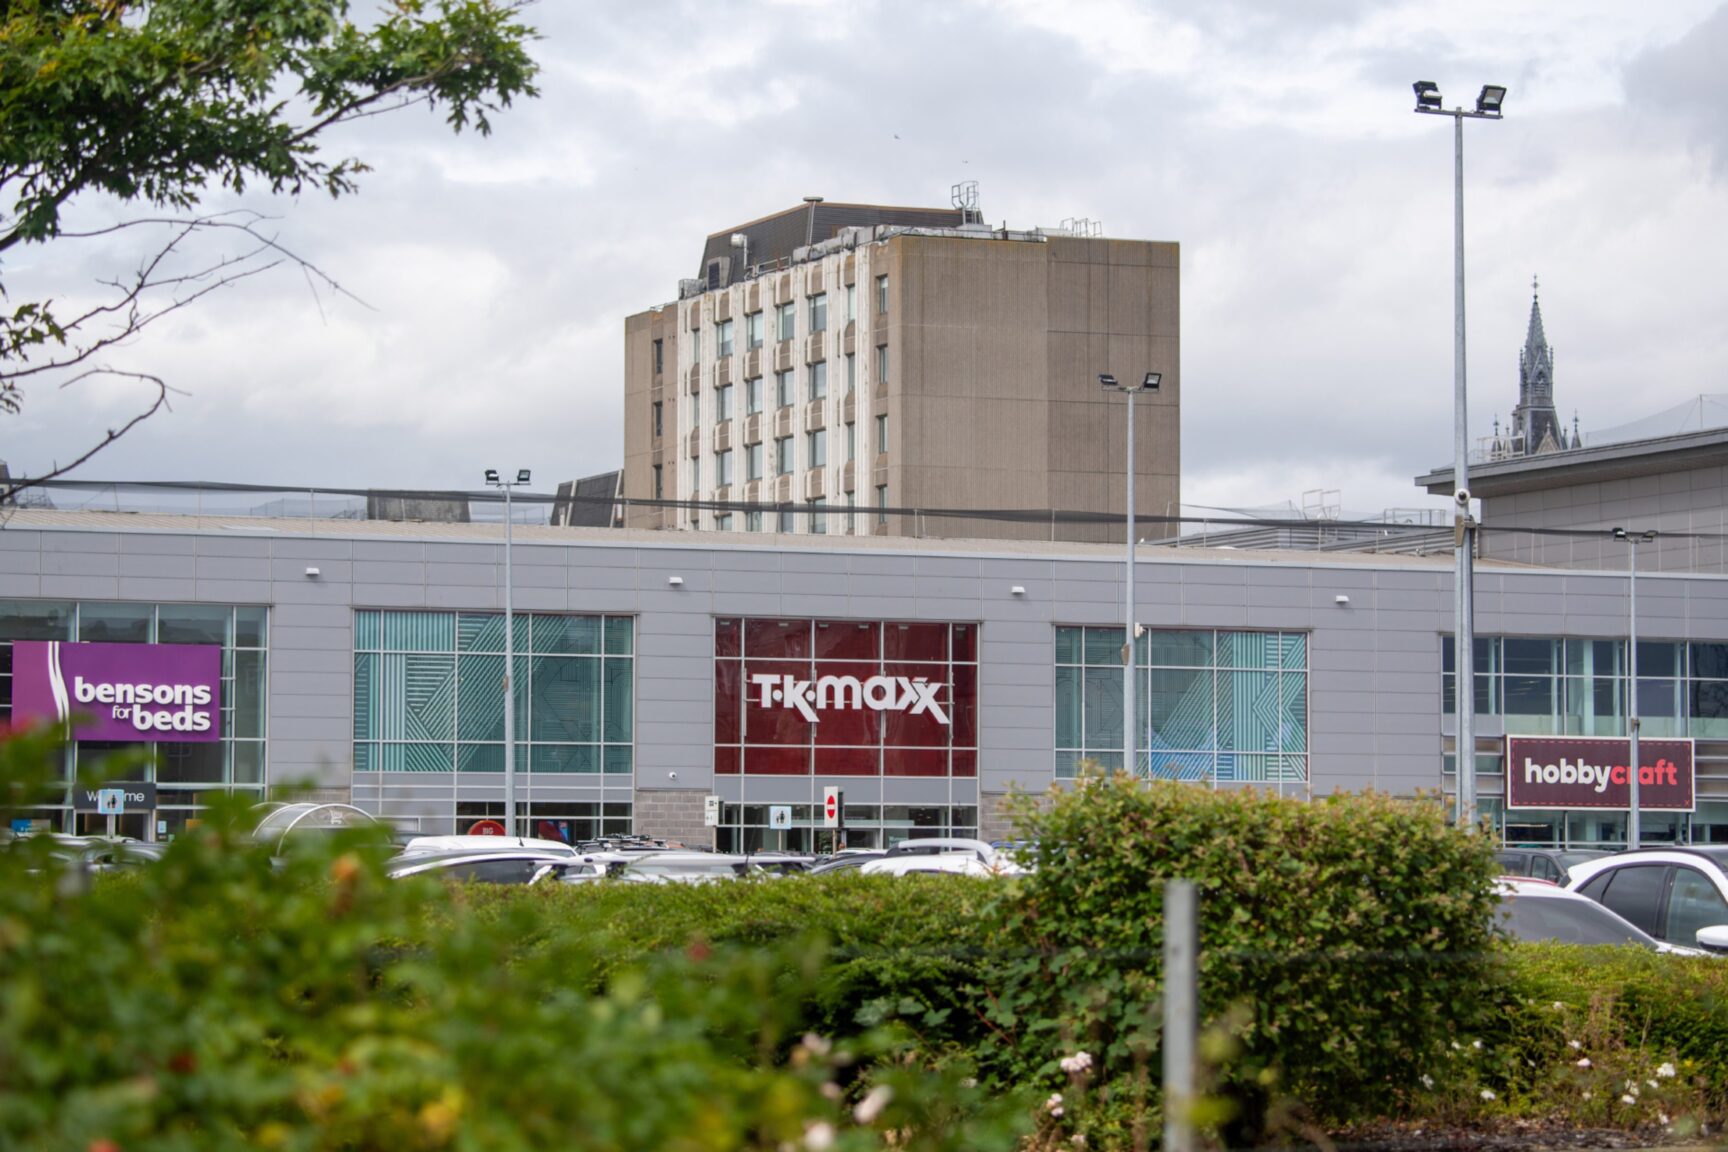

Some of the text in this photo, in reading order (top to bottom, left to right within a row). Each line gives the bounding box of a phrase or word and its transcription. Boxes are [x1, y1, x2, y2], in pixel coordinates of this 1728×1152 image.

[74, 676, 212, 705] bensons
[112, 704, 212, 731] for beds
